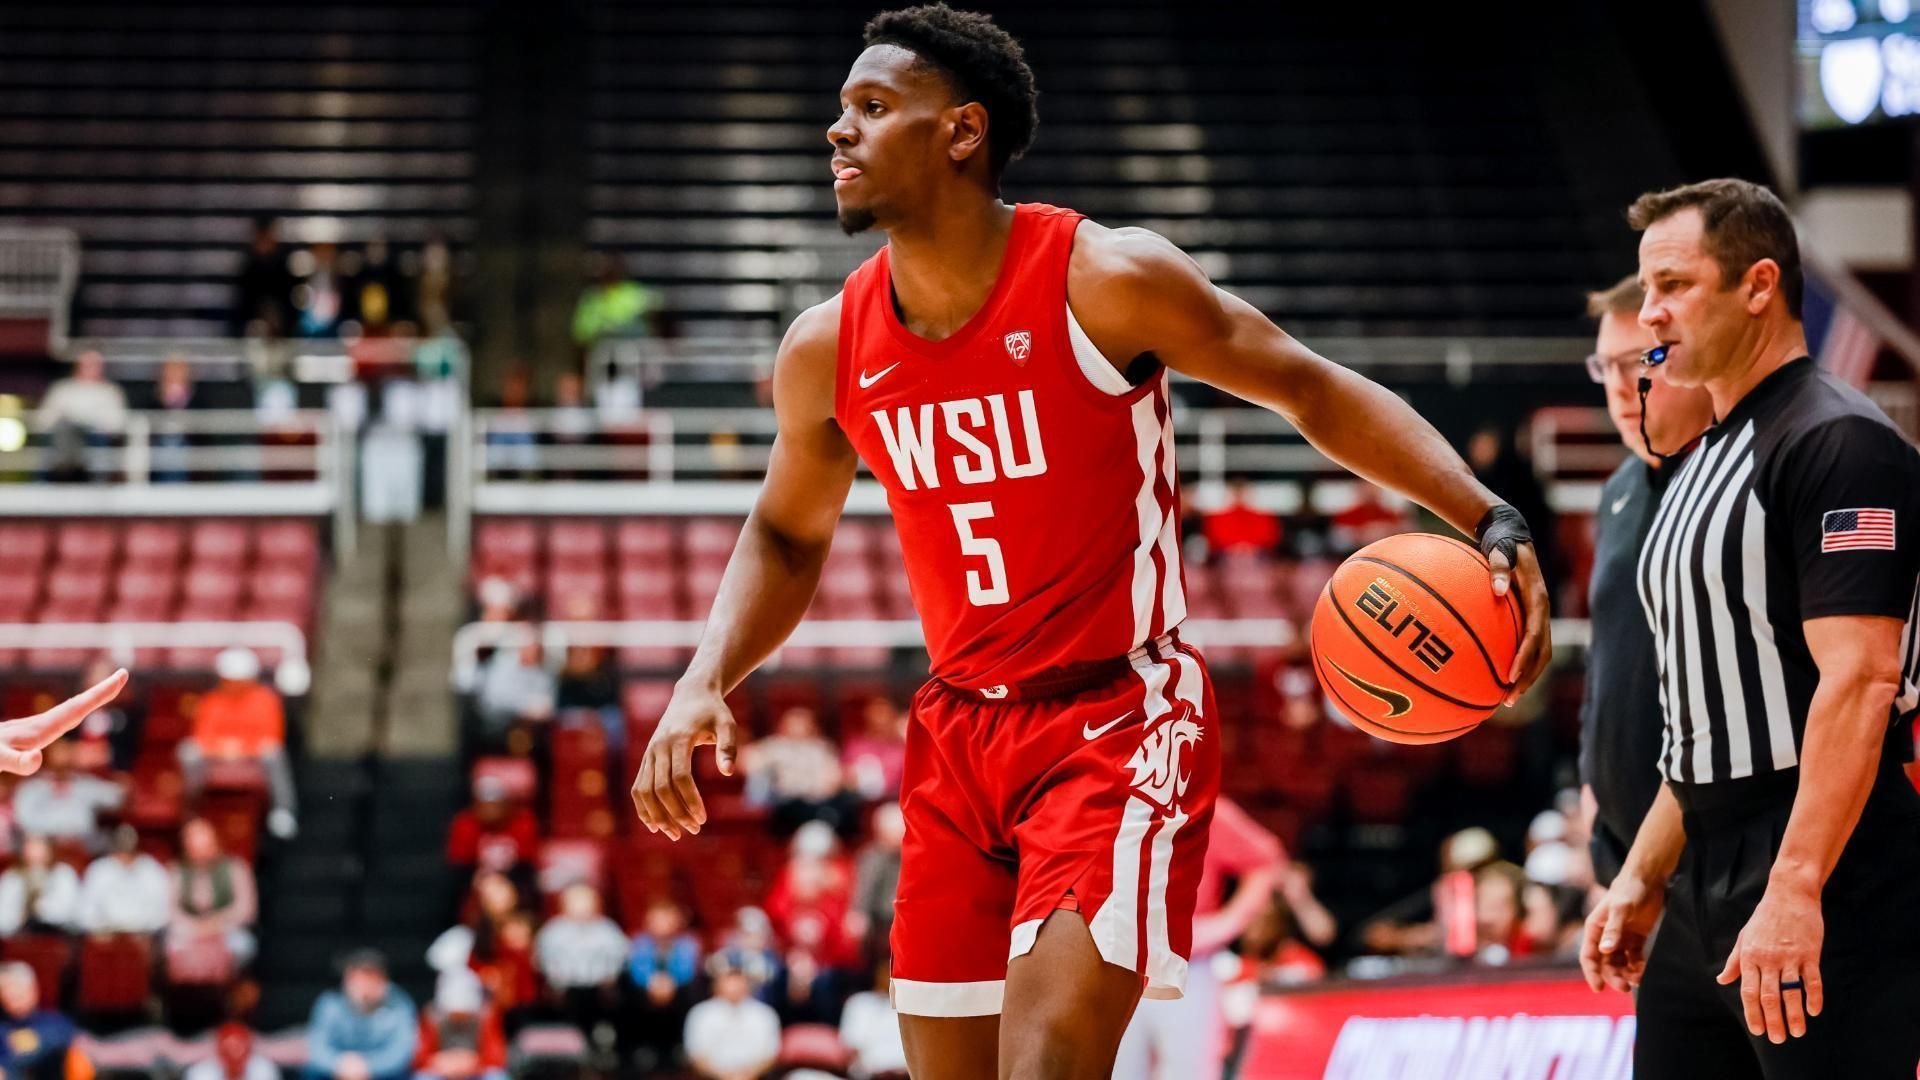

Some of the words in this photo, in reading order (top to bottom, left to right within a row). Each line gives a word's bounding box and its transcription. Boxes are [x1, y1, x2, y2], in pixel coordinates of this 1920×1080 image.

[1005, 331, 1030, 354] PAC
[1013, 346, 1027, 360] 12
[870, 389, 1048, 491] WSU
[947, 501, 1010, 607] 5
[1355, 582, 1455, 674] ELITE
